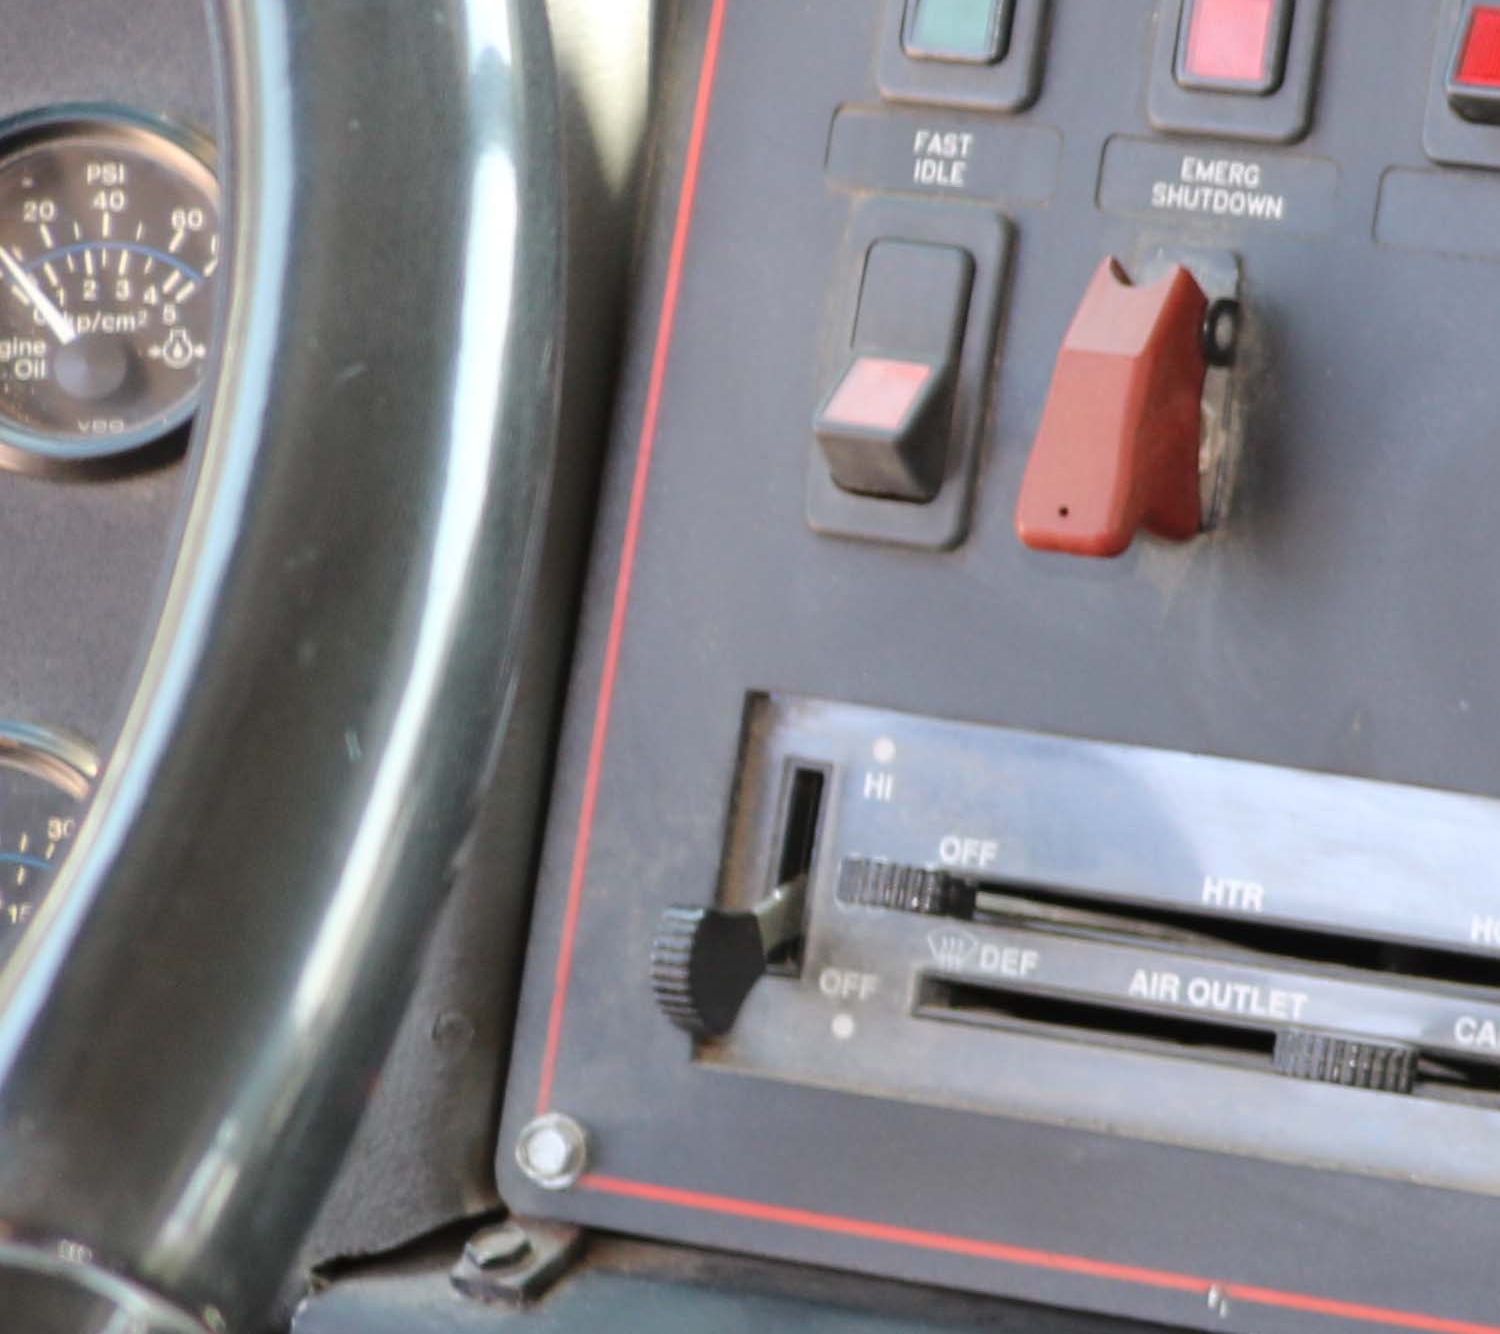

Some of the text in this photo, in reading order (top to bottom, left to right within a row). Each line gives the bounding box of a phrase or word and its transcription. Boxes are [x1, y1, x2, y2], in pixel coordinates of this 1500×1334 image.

[913, 129, 973, 157] FAST
[86, 162, 126, 185] PSI
[913, 158, 967, 187] IDLE
[1180, 155, 1262, 190] EMERG
[23, 189, 204, 231] 20 40 60
[1151, 182, 1284, 220] SHUTDOWN
[83, 280, 97, 301] 2
[115, 280, 130, 302] 3
[14, 357, 48, 381] Oil
[863, 770, 895, 802] HI
[938, 834, 998, 868] OFF
[1201, 875, 1265, 913] HTR
[979, 942, 1040, 977] DEF
[818, 967, 879, 1001] OFF
[1127, 968, 1309, 1020] AIR OUTLET
